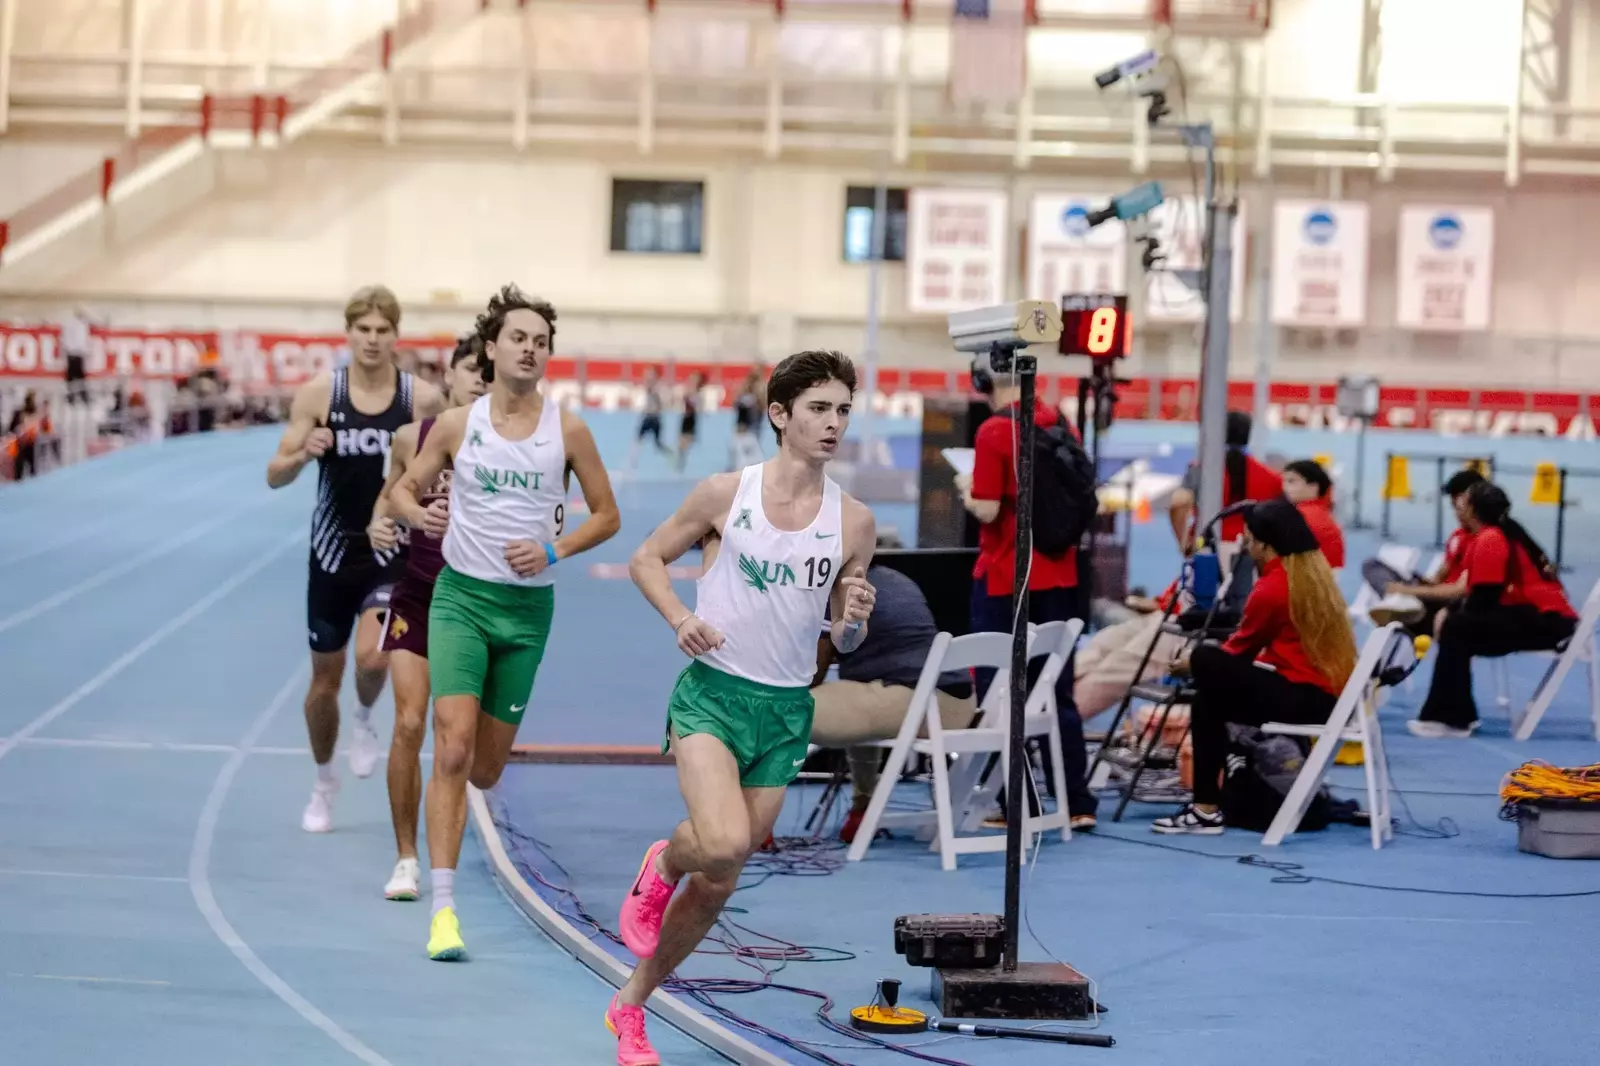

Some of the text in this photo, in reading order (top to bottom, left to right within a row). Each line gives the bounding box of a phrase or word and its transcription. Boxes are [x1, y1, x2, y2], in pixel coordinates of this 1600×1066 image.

[1087, 307, 1117, 353] 8
[492, 468, 544, 490] UNT
[555, 504, 564, 536] 9
[762, 560, 796, 587] UN
[804, 557, 832, 588] 19
